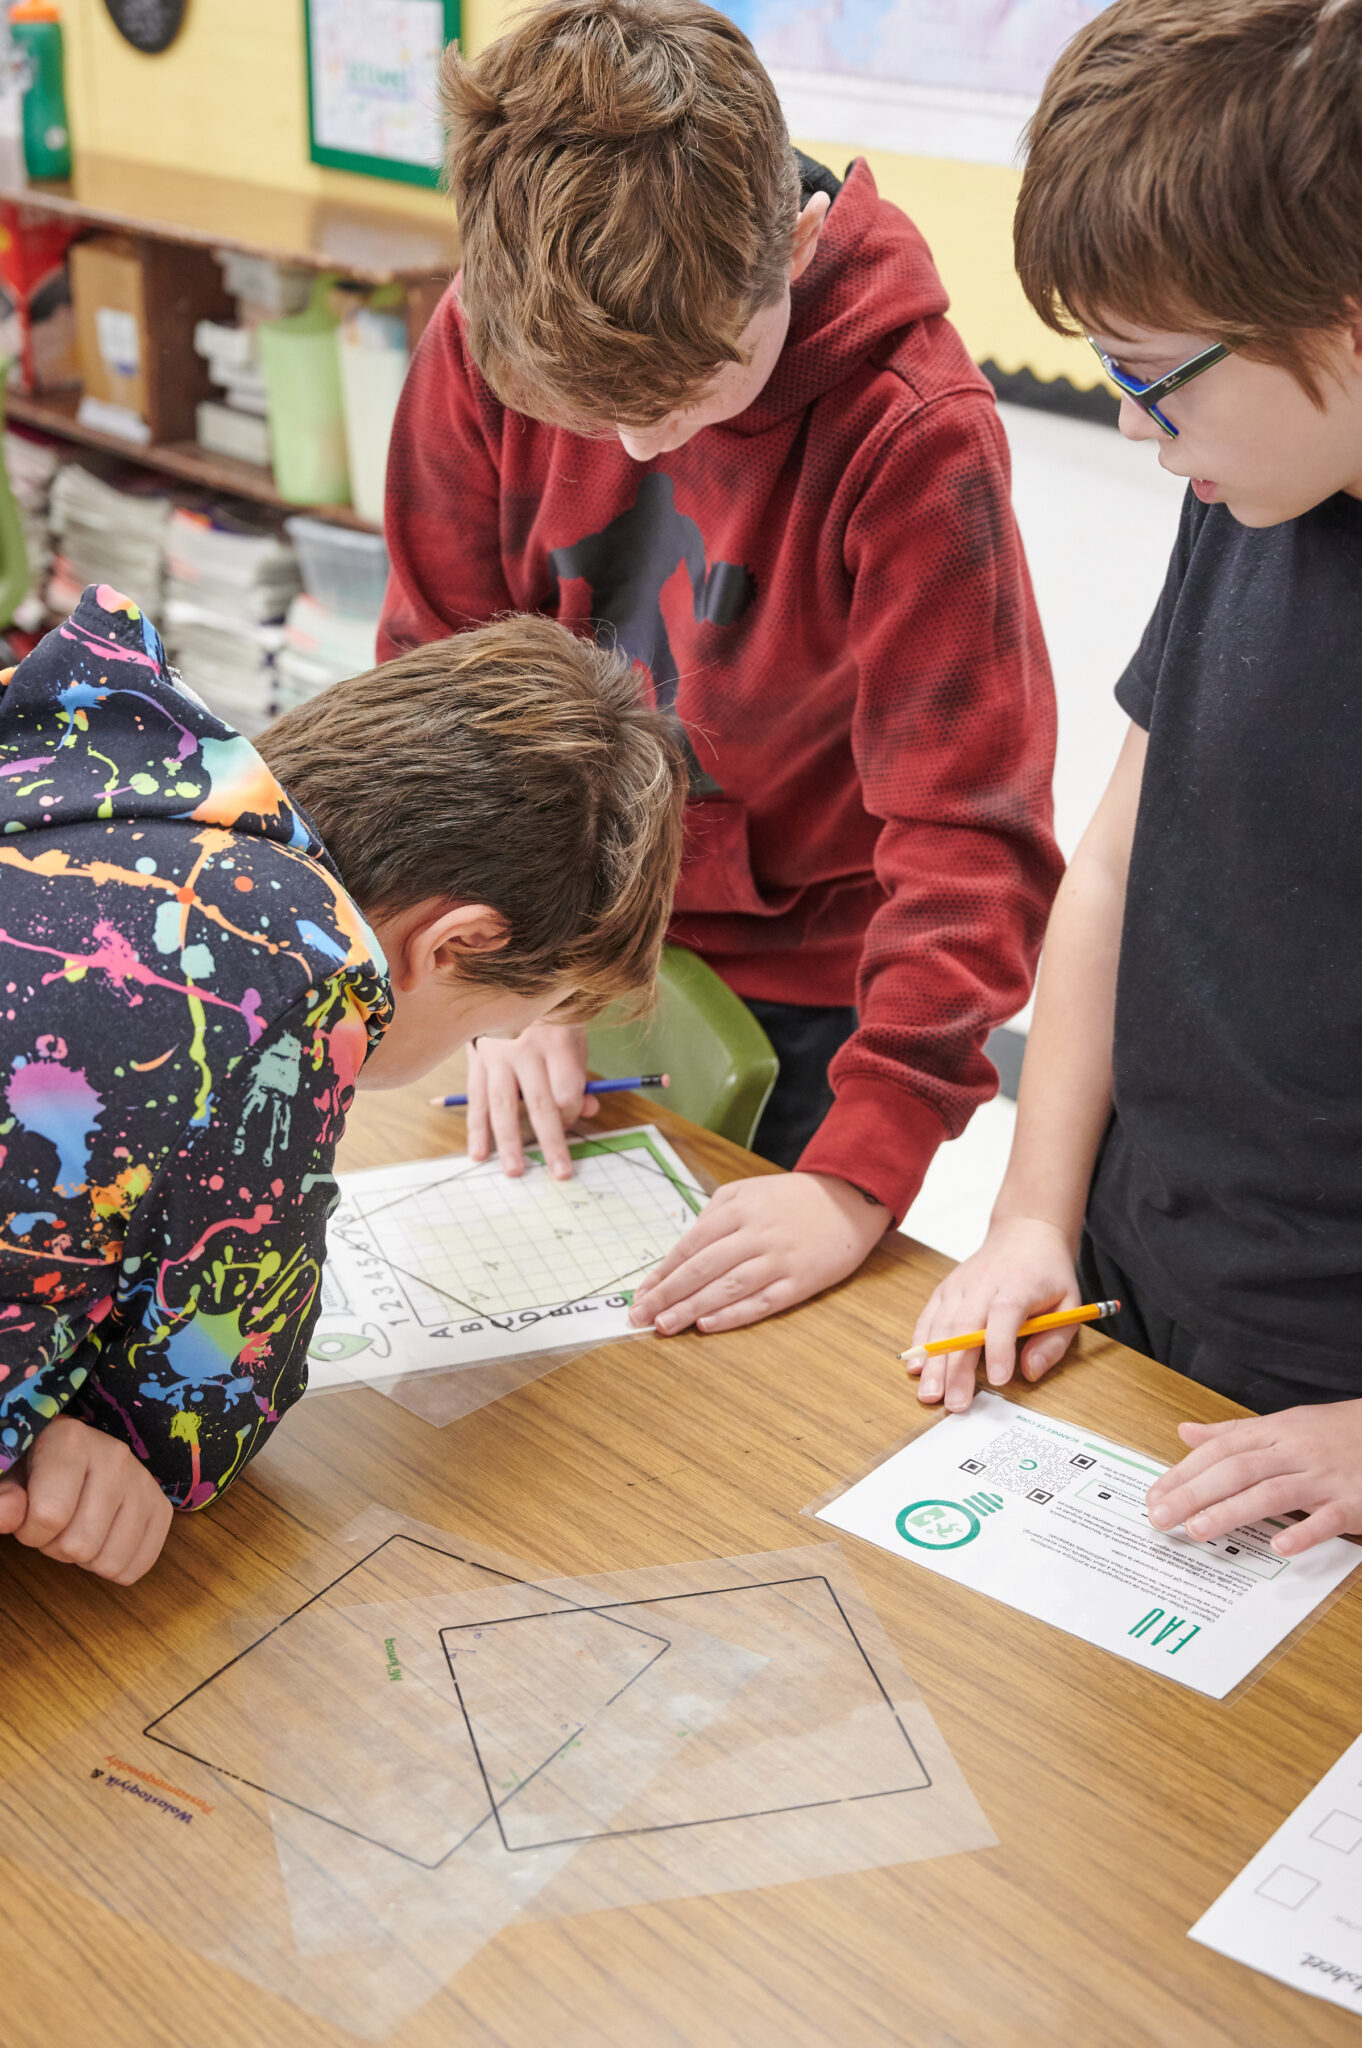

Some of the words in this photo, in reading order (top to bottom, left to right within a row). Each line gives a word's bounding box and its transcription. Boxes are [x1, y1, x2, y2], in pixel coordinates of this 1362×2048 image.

[348, 1242, 370, 1252] 6
[356, 1258, 379, 1267] 5
[362, 1271, 385, 1280] 4
[371, 1286, 394, 1296] 3
[379, 1300, 404, 1311] 2
[387, 1318, 410, 1326] 1
[429, 1327, 454, 1338] A
[460, 1322, 484, 1333] B
[491, 1317, 514, 1329] C
[519, 1311, 541, 1323] D
[575, 1304, 598, 1313] F
[606, 1296, 628, 1308] G
[1127, 1607, 1203, 1655] EAU
[91, 1768, 104, 1779] &
